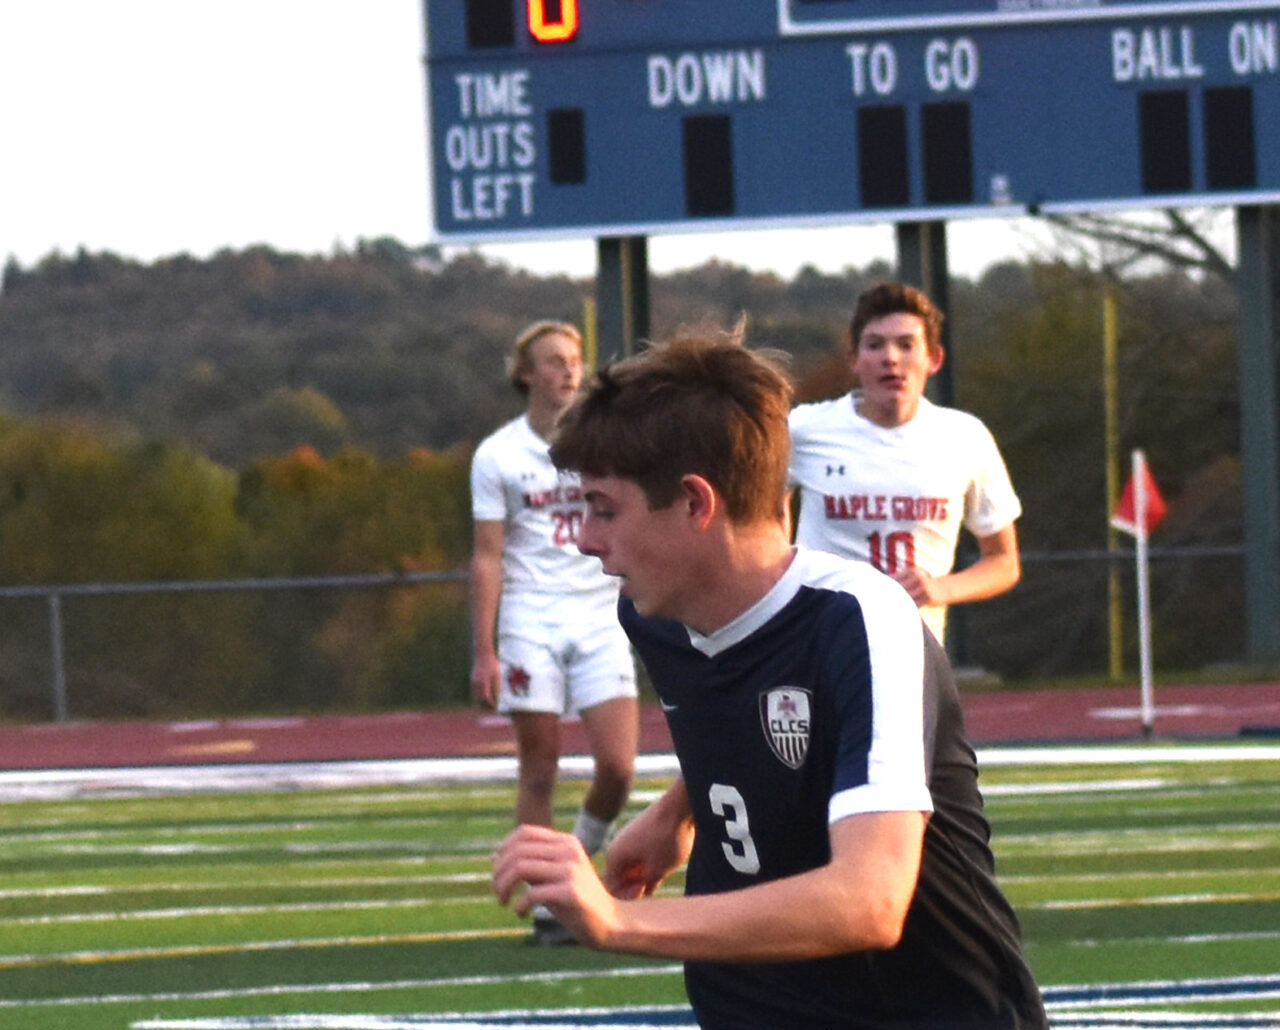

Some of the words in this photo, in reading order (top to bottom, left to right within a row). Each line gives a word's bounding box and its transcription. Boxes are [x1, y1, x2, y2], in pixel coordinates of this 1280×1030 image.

[845, 42, 898, 96] TO
[924, 37, 979, 92] GO
[1111, 26, 1203, 82] BALL
[1228, 21, 1279, 75] ON
[455, 69, 533, 118] TIME
[647, 50, 765, 107] DOWN
[445, 121, 536, 172] OUTS
[451, 172, 535, 221] LEFT
[824, 495, 887, 520] MAPLE
[892, 495, 949, 521] GROVE
[867, 529, 915, 575] 10
[771, 719, 809, 734] CLCS
[708, 782, 760, 875] 3
